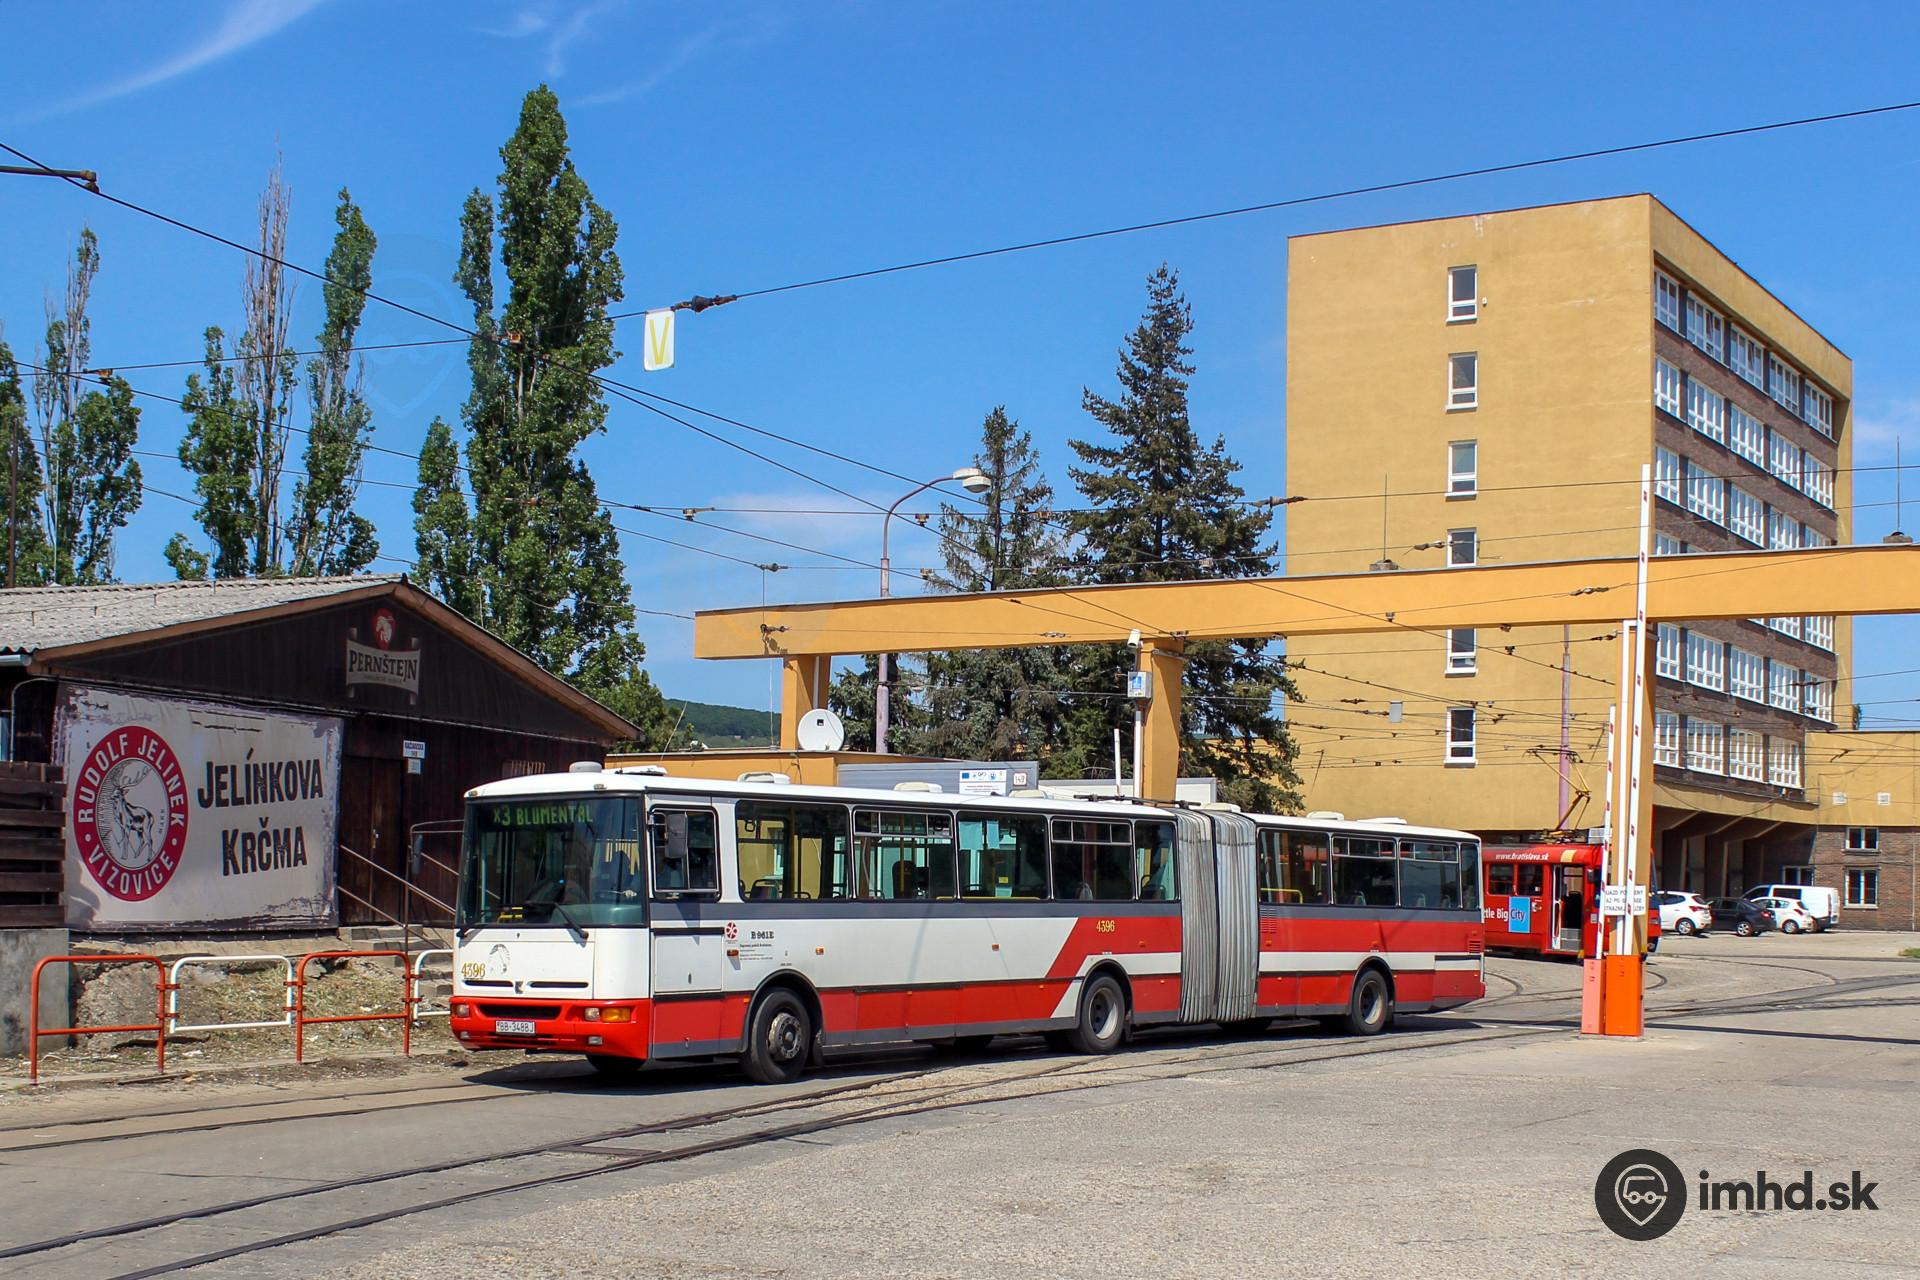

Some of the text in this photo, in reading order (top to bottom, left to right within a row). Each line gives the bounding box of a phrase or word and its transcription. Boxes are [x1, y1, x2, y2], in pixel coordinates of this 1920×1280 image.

[649, 317, 670, 365] V
[349, 649, 418, 682] PERNŠTEJN
[78, 733, 184, 827] RUDOLF JELINEK
[197, 747, 324, 809] JELÍNKOVA
[88, 844, 175, 895] VIZOVICE
[222, 816, 308, 876] KRČMA
[1096, 919, 1115, 932] 4396
[1496, 908, 1509, 922] Big
[1510, 909, 1525, 922] City
[461, 962, 486, 978] 4396
